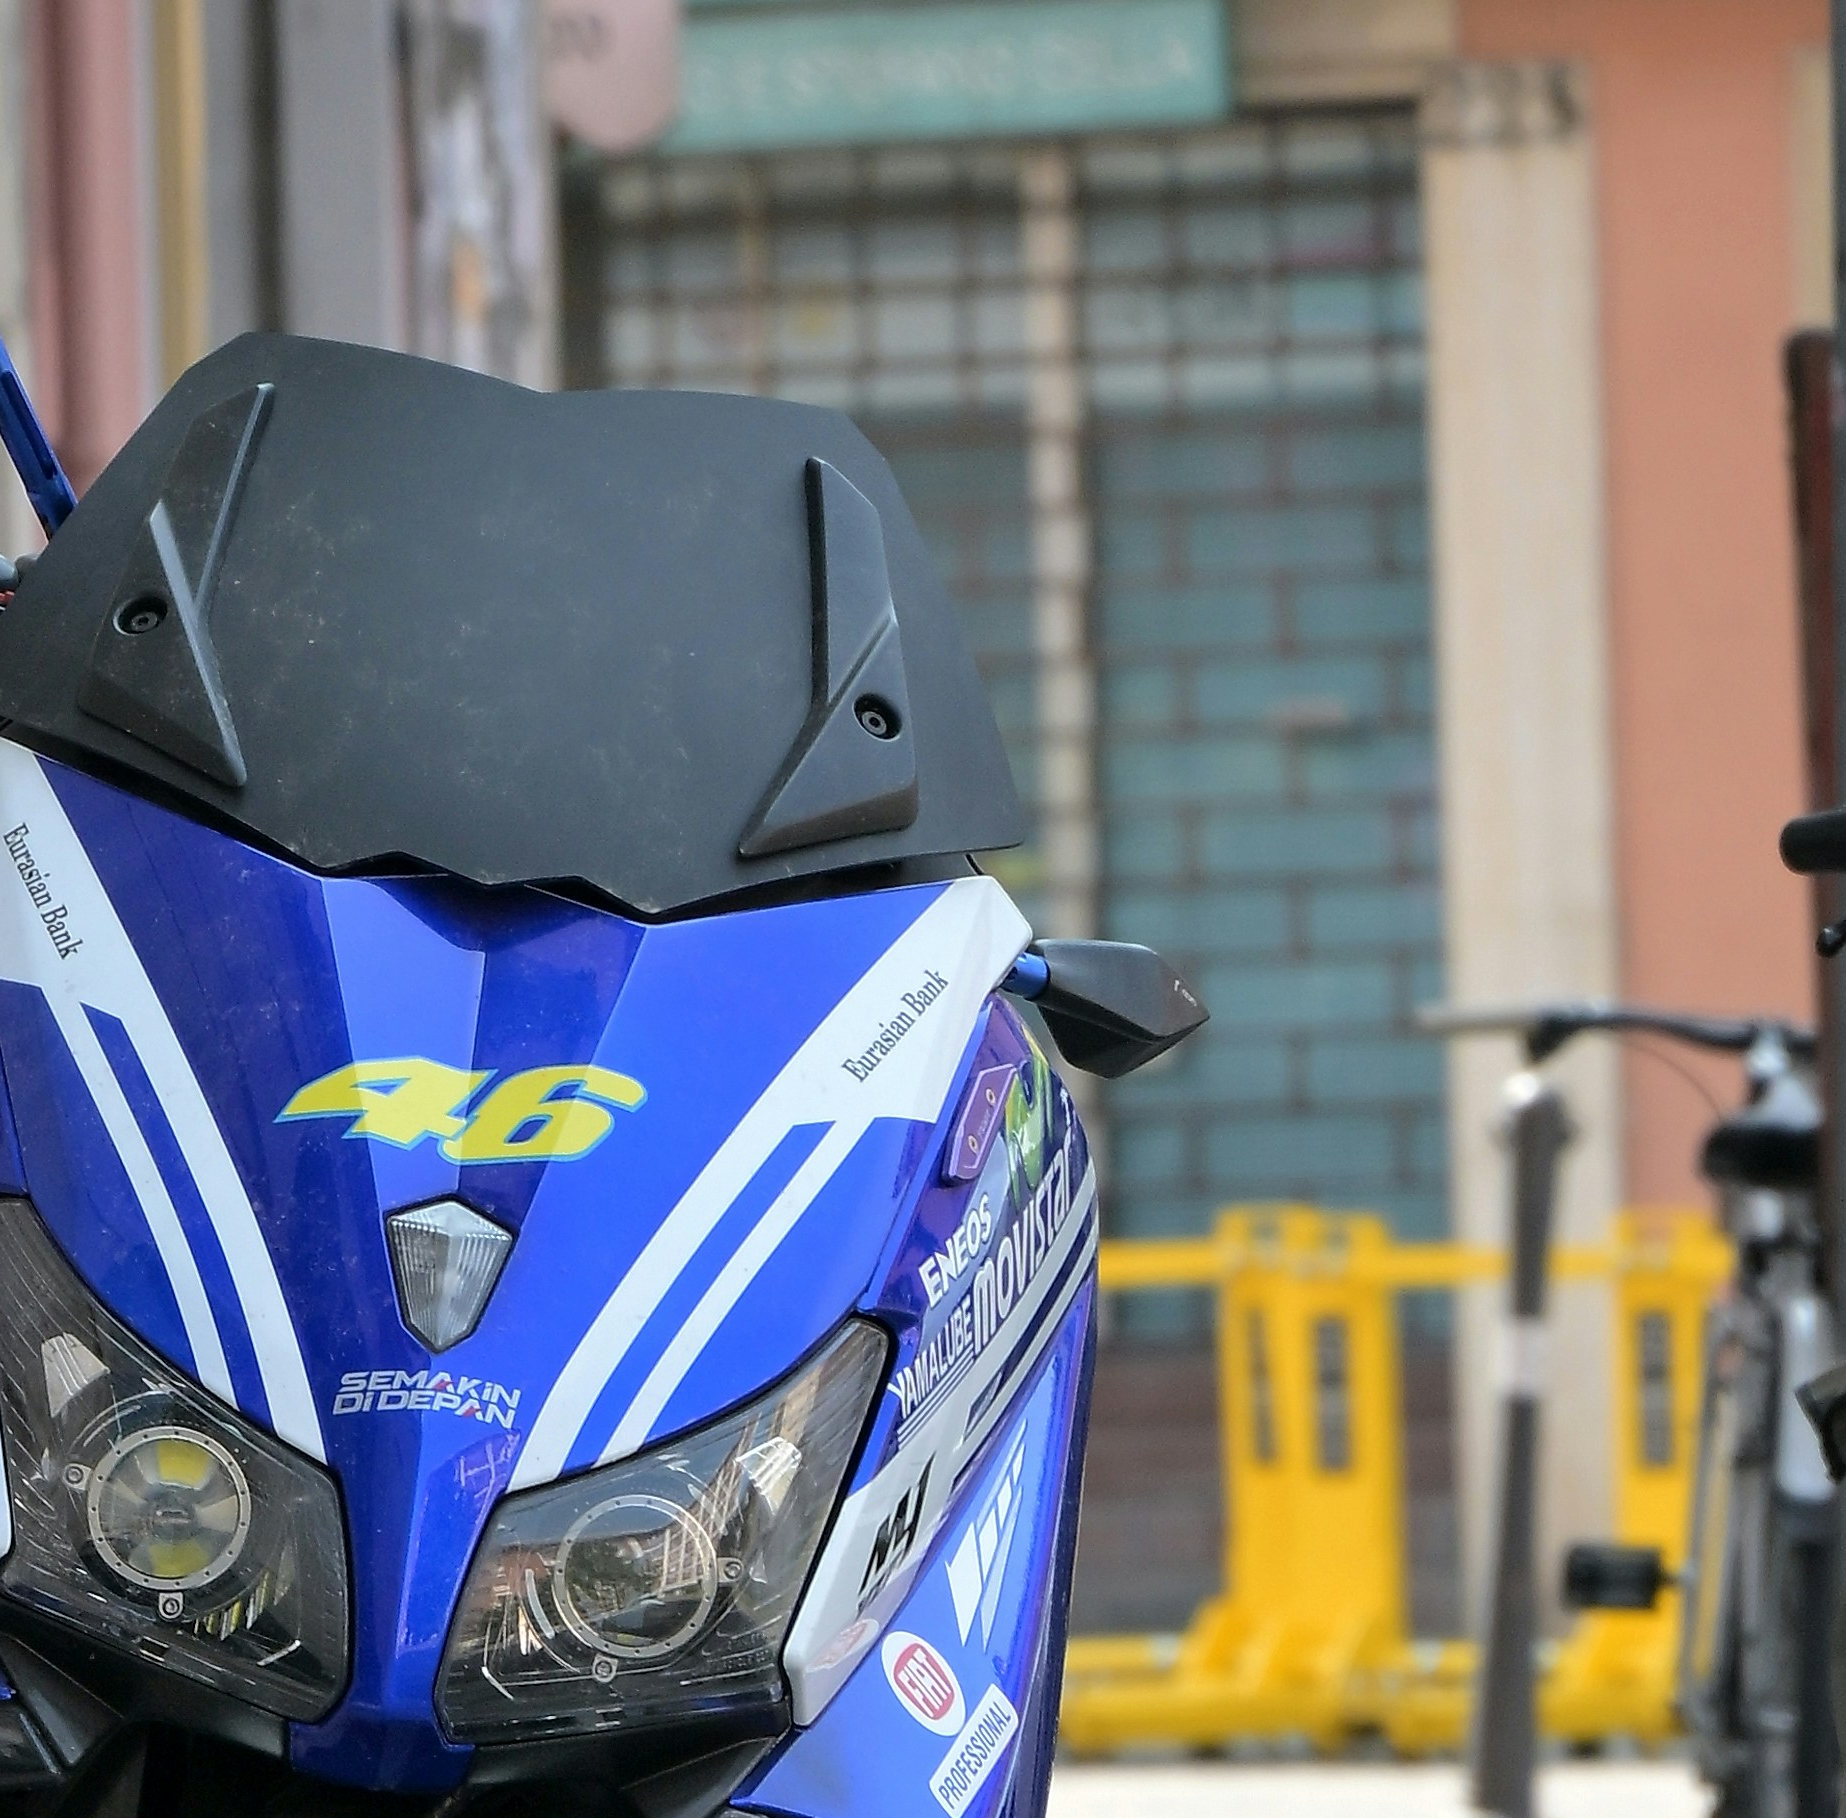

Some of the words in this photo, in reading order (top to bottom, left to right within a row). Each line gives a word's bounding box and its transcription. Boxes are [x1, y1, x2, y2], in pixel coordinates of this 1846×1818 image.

[3, 822, 52, 909] Eurasian
[40, 904, 84, 960] Bank
[841, 1012, 915, 1082] Eurasian
[900, 969, 949, 1017] Bank
[273, 1056, 648, 1165] 46
[918, 1193, 992, 1308] ENEOS
[376, 1390, 517, 1430] DEPAN
[887, 1293, 975, 1418] YAMALUBE
[897, 1646, 952, 1720] FIAT
[938, 1701, 1012, 1810] PROFESSIONAL
